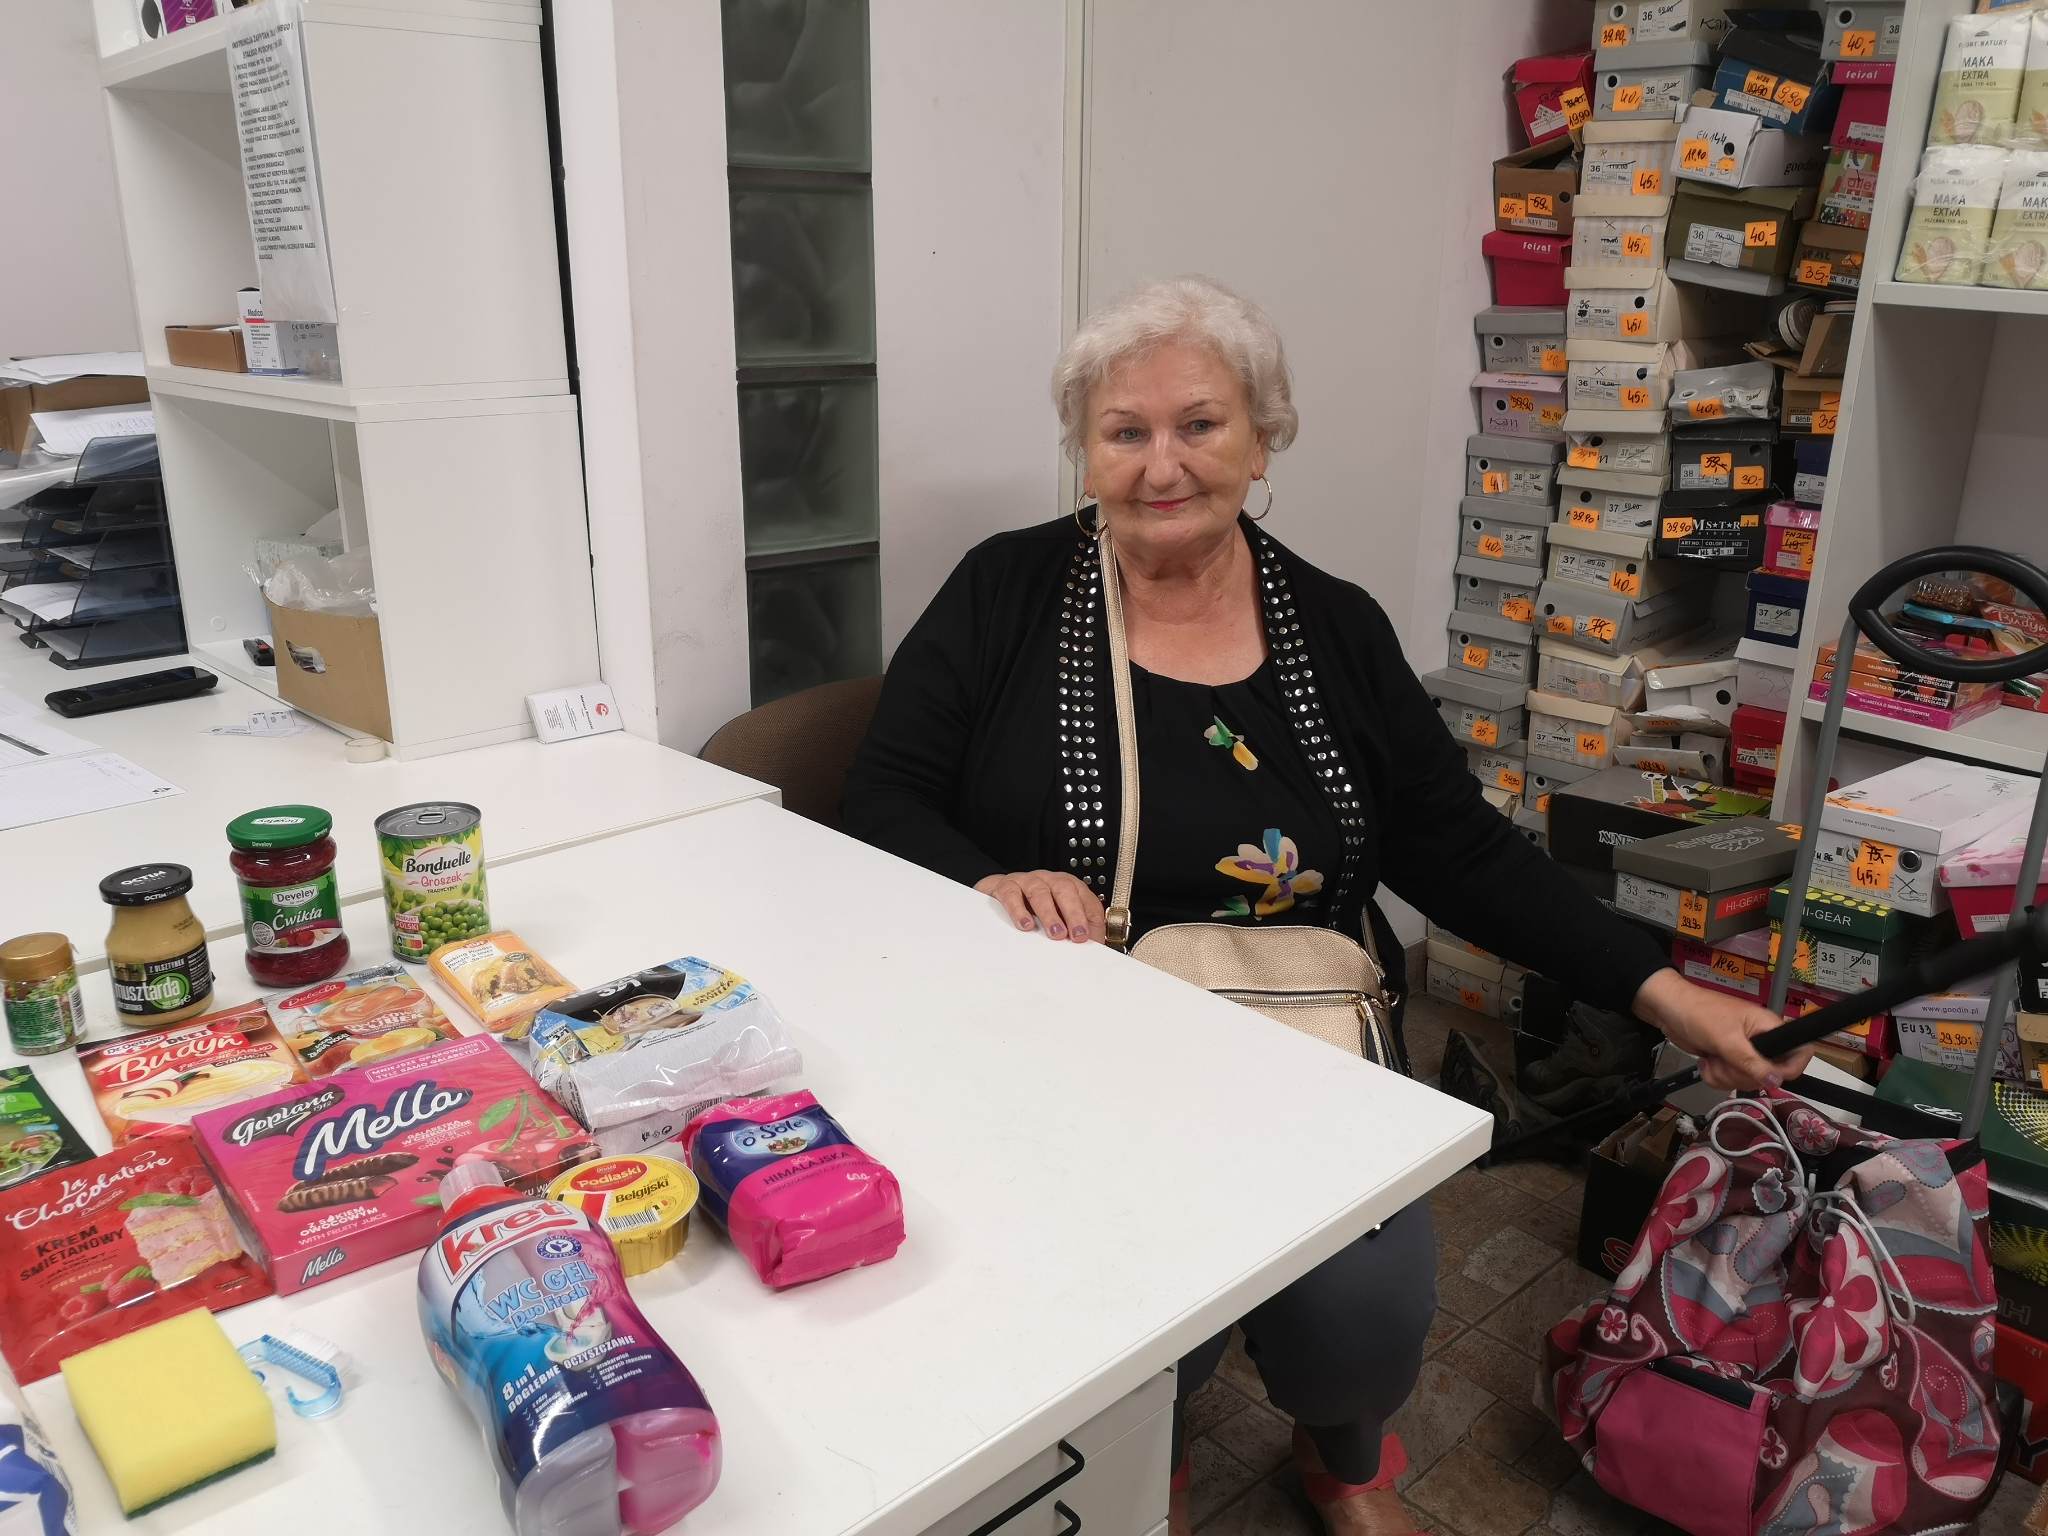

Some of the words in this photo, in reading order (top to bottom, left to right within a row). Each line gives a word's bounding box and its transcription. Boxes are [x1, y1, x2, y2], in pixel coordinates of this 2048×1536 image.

[1642, 11, 1653, 21] 36
[1590, 165, 1601, 173] 36
[1561, 556, 1575, 565] 37
[405, 851, 472, 876] Bonduelle
[120, 870, 167, 886] OCTIM
[420, 871, 463, 888] Groszek
[276, 887, 315, 903] Develey
[272, 907, 323, 932] Ćwikła
[395, 923, 419, 932] POLSKI
[1821, 952, 1836, 964] 35
[114, 976, 181, 1001] musztarda
[1921, 1005, 1979, 1015] www.goodin.pl
[1901, 1023, 1916, 1033] EU
[111, 1034, 244, 1083] Budyń
[215, 1052, 268, 1067] CYNAMON
[232, 1089, 335, 1147] Goplana
[304, 1083, 463, 1175] Mella
[577, 1165, 643, 1188] Podlaski
[763, 1151, 851, 1186] HIMALAJSKA
[56, 1178, 88, 1204] La
[615, 1178, 670, 1204] Belgijski
[299, 1207, 378, 1237] OWOCOWYM
[35, 1225, 99, 1257] KREM
[440, 1200, 567, 1277] Kret
[302, 1246, 346, 1284] Mella
[487, 1274, 541, 1322] WC
[544, 1260, 600, 1293] GEL
[509, 1302, 546, 1331] Duo
[507, 1363, 561, 1414] DOGŁĘBNE
[563, 1334, 636, 1369] OCZYSZCZANIE
[502, 1380, 515, 1400] 8
